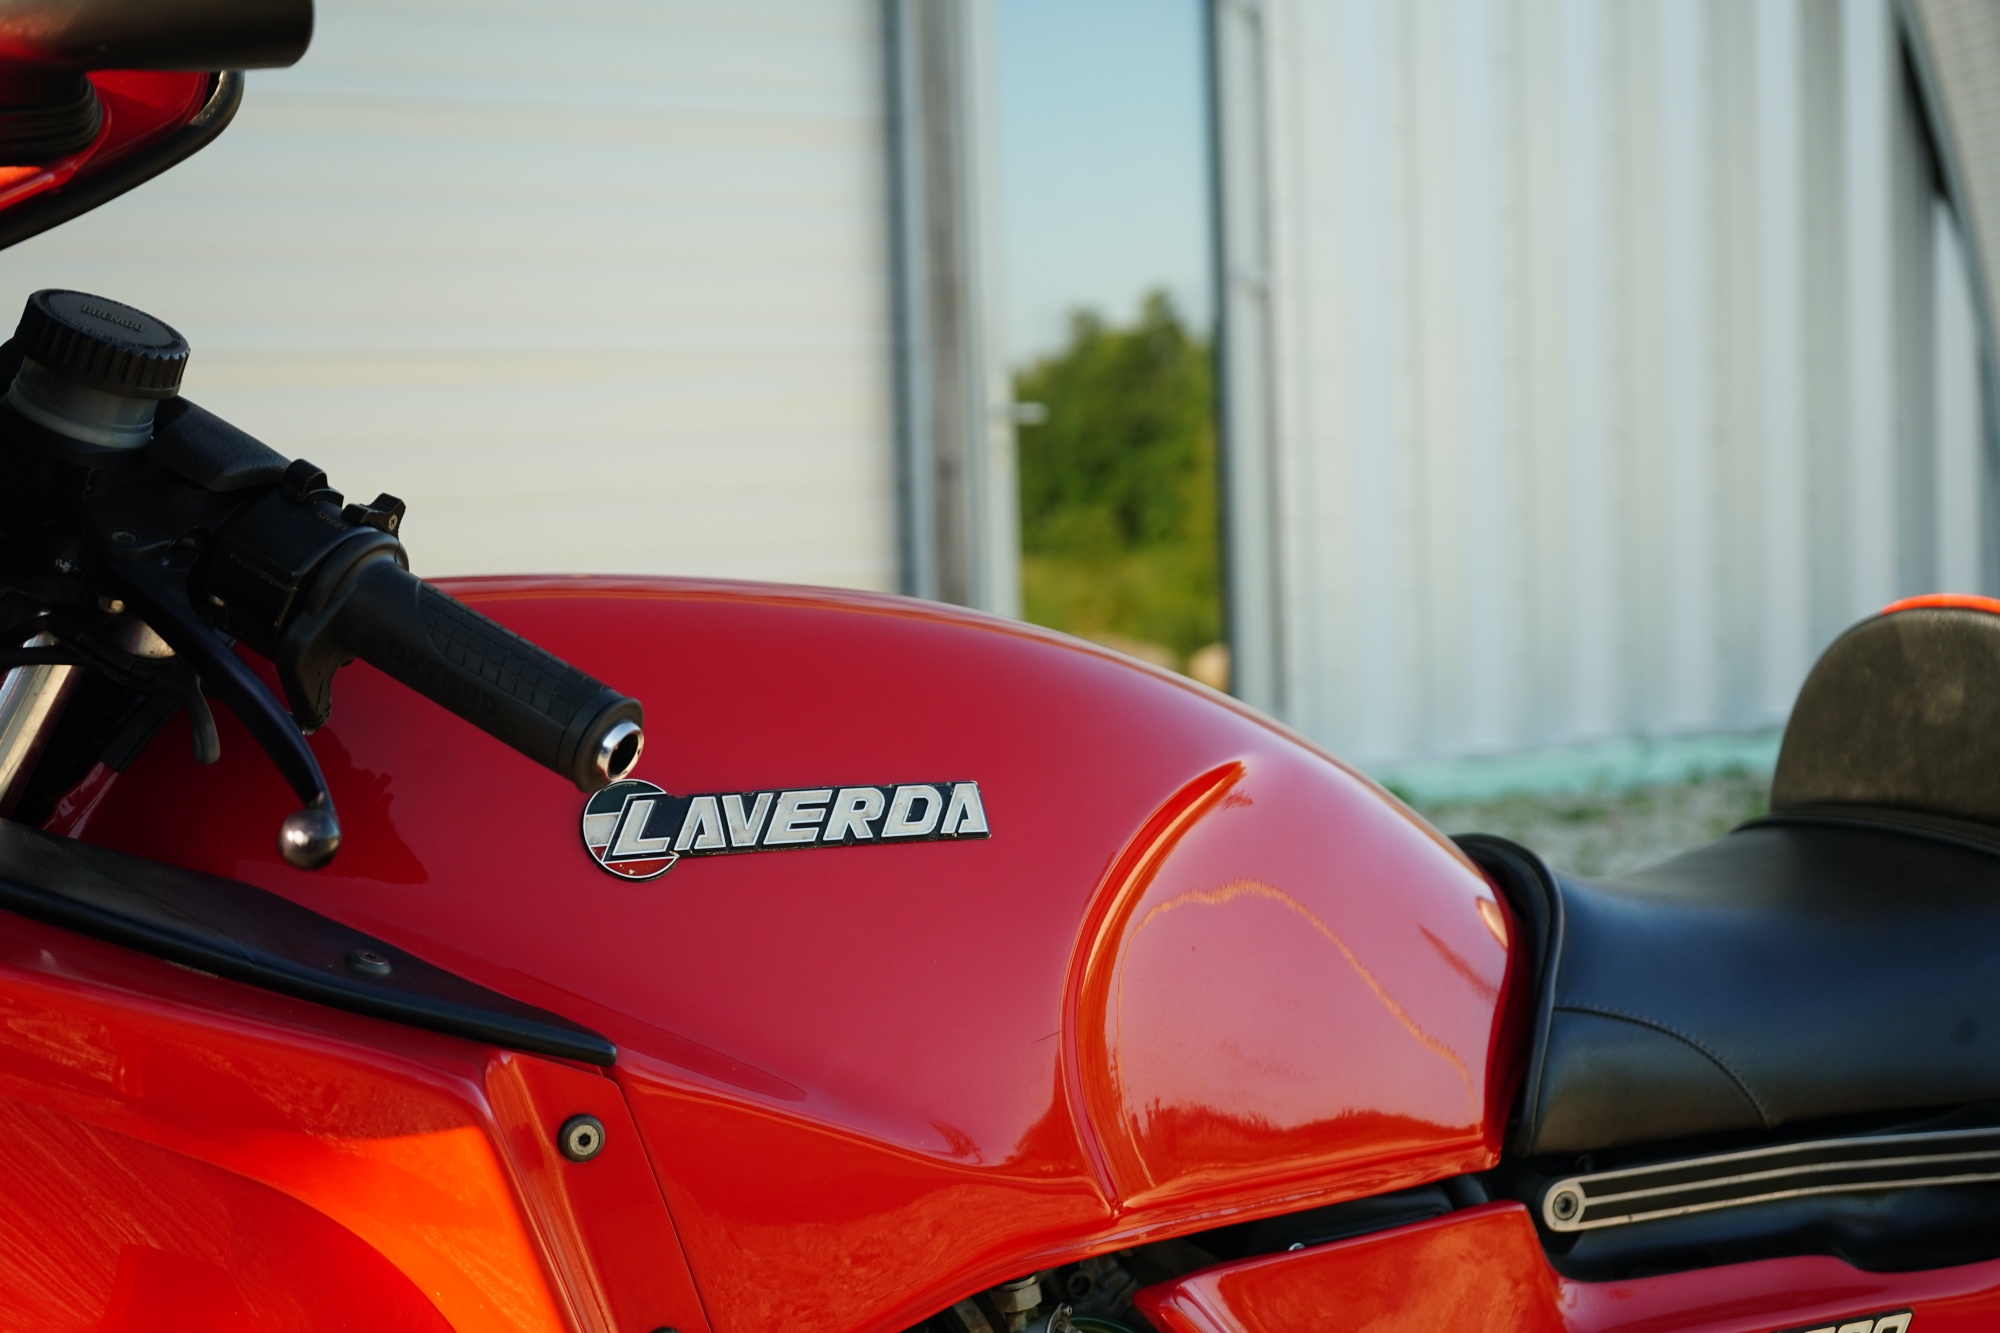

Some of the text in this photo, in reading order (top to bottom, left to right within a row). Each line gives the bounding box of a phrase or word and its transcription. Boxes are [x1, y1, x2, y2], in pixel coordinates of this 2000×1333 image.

[81, 305, 144, 332] BREMBO
[386, 641, 497, 716] OXFORD
[611, 782, 990, 856] LAVERDA
